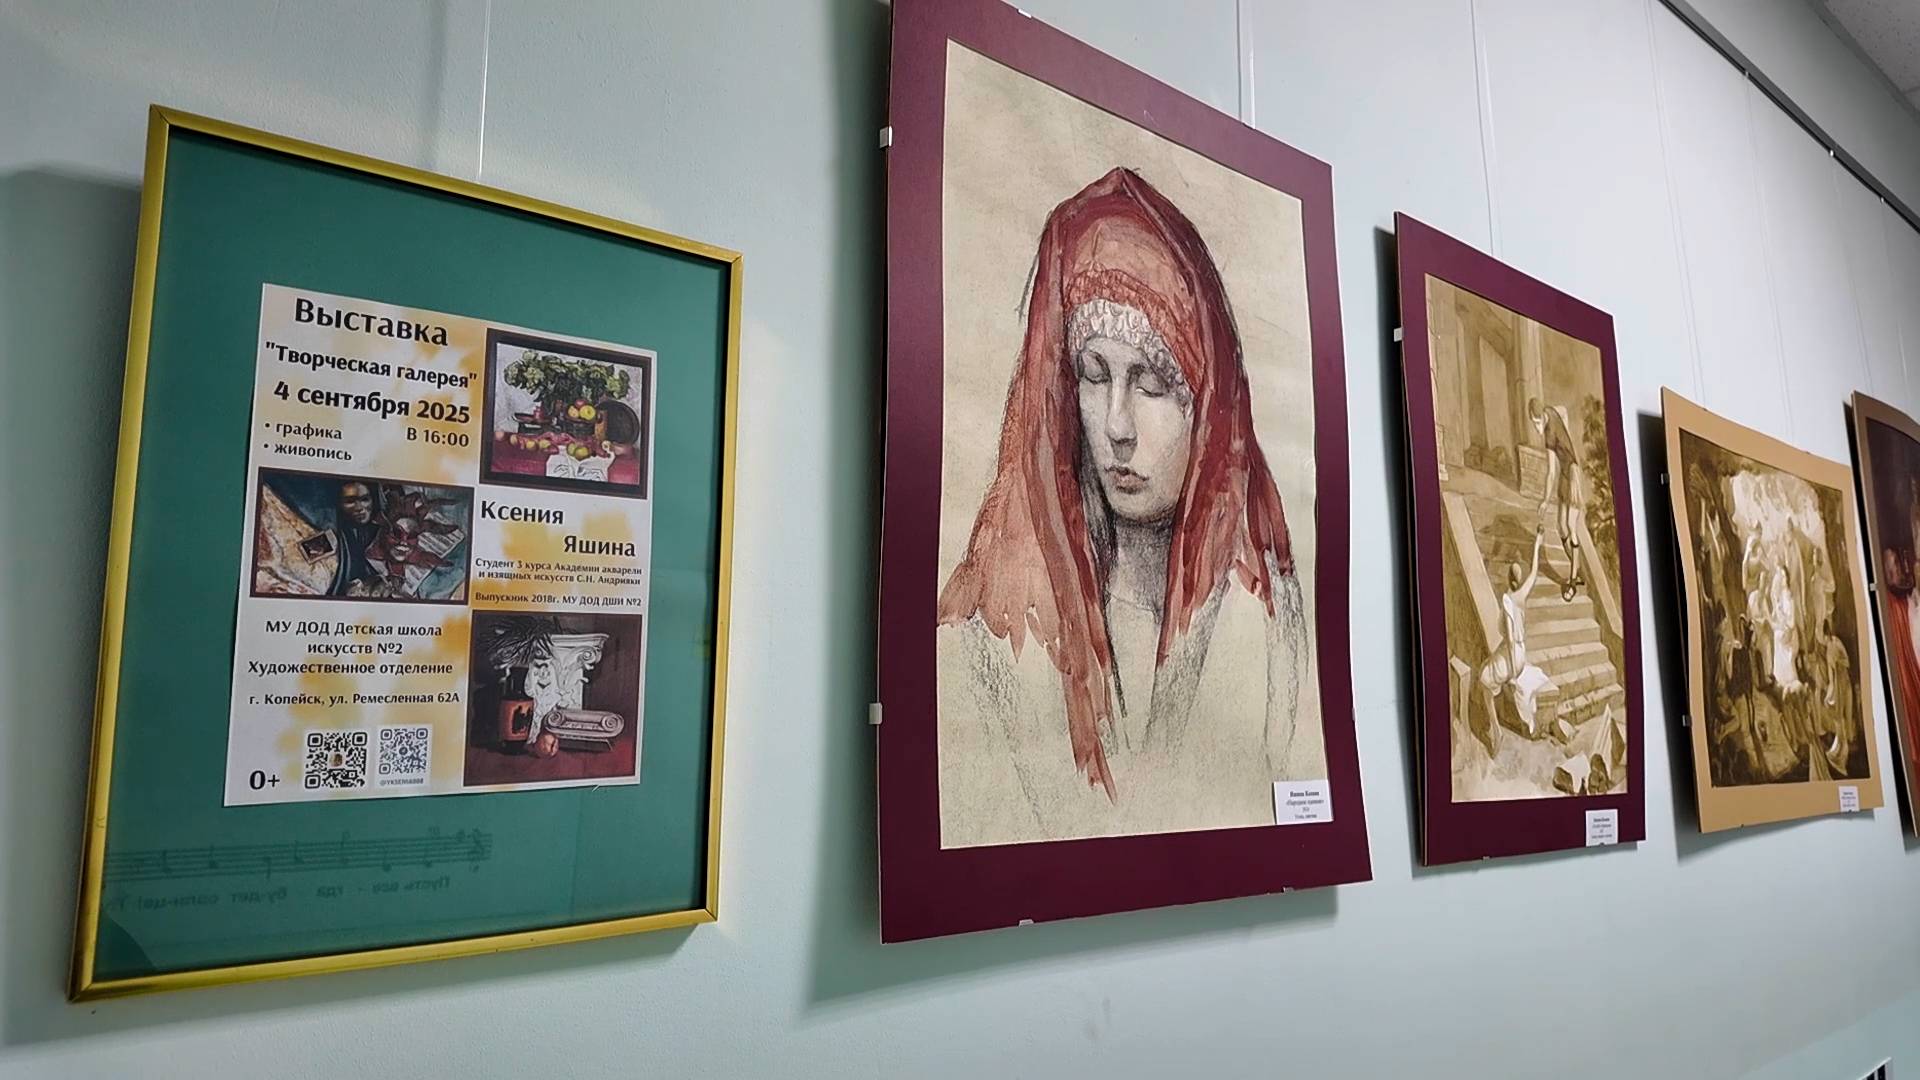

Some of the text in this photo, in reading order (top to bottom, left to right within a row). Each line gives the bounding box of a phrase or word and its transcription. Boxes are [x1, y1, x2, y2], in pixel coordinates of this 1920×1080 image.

[295, 298, 448, 346] Выставка
[265, 341, 477, 389] "Творческая галерея"
[274, 381, 470, 424] 4 сентября 2025
[275, 423, 343, 440] графика
[406, 427, 469, 447] В 16:00
[274, 442, 352, 461] живопись
[481, 500, 564, 524] Ксения
[564, 535, 635, 557] Яшина
[475, 558, 642, 576] Студент 3 курса Академии акварели
[487, 572, 533, 581] изящных
[534, 574, 574, 584] искусств
[597, 576, 641, 586] Андрияки
[475, 592, 529, 604] Выпускник
[562, 596, 578, 605] МУ
[579, 596, 600, 606] ДОД
[602, 597, 624, 607] ДШИ
[626, 598, 642, 607] №2
[265, 620, 442, 637] МУ ДОД Детская школа
[307, 642, 403, 657] искусств №2
[248, 661, 453, 677] Художественное отделение
[249, 692, 460, 708] г. Копейск, ул. Ремесленная 62А
[249, 770, 281, 790] 0+
